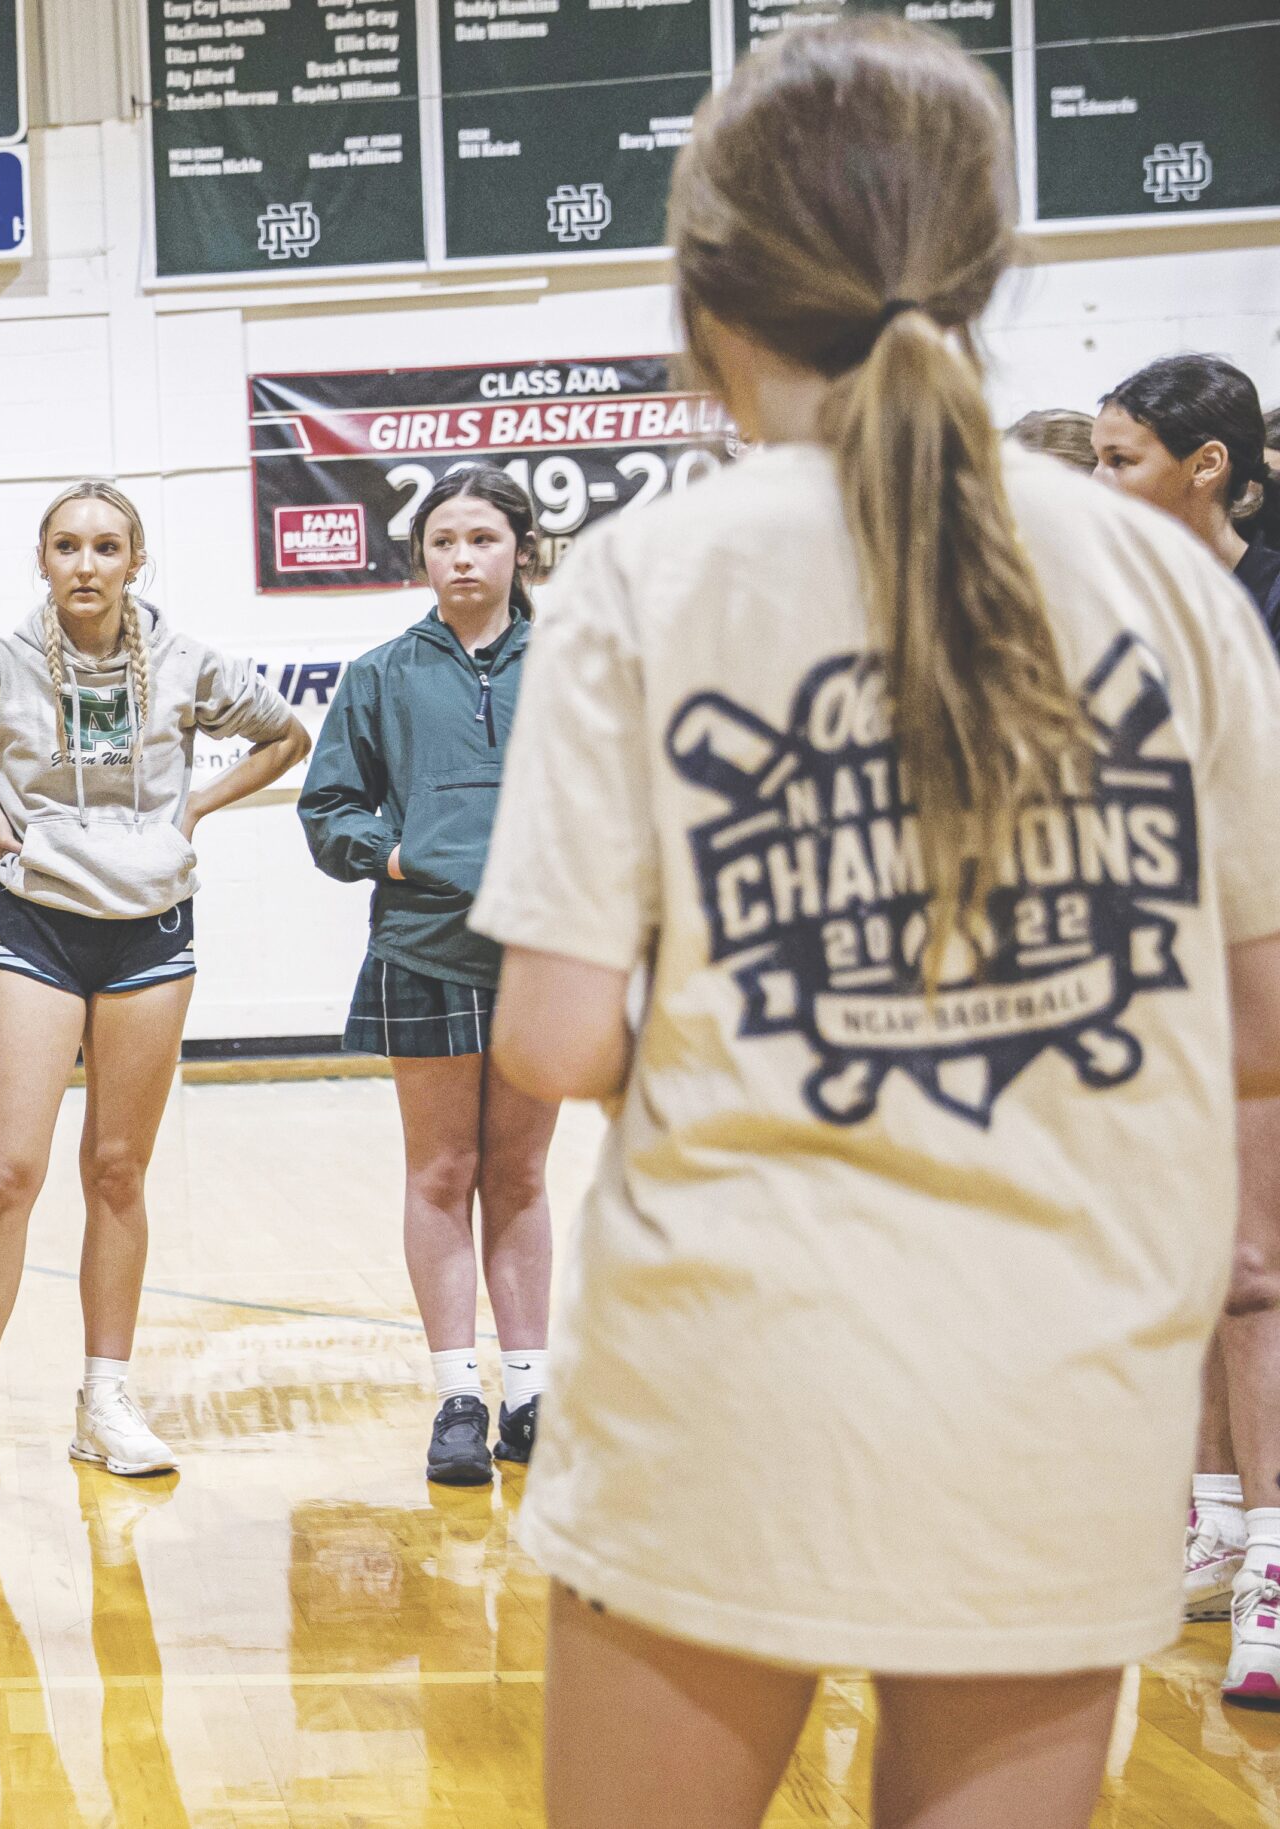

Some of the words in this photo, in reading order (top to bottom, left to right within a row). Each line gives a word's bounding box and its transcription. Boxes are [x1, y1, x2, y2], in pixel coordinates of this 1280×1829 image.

[224, 18, 266, 37] Smith
[366, 9, 399, 28] Gray
[366, 32, 400, 52] Gray
[478, 370, 562, 399] CLASS
[564, 367, 620, 394] AAA
[369, 410, 482, 451] GIRLS
[302, 512, 356, 531] FARM
[283, 529, 357, 549] BUREAU
[716, 801, 1182, 941] CHAMIONS
[1014, 892, 1093, 946] 22
